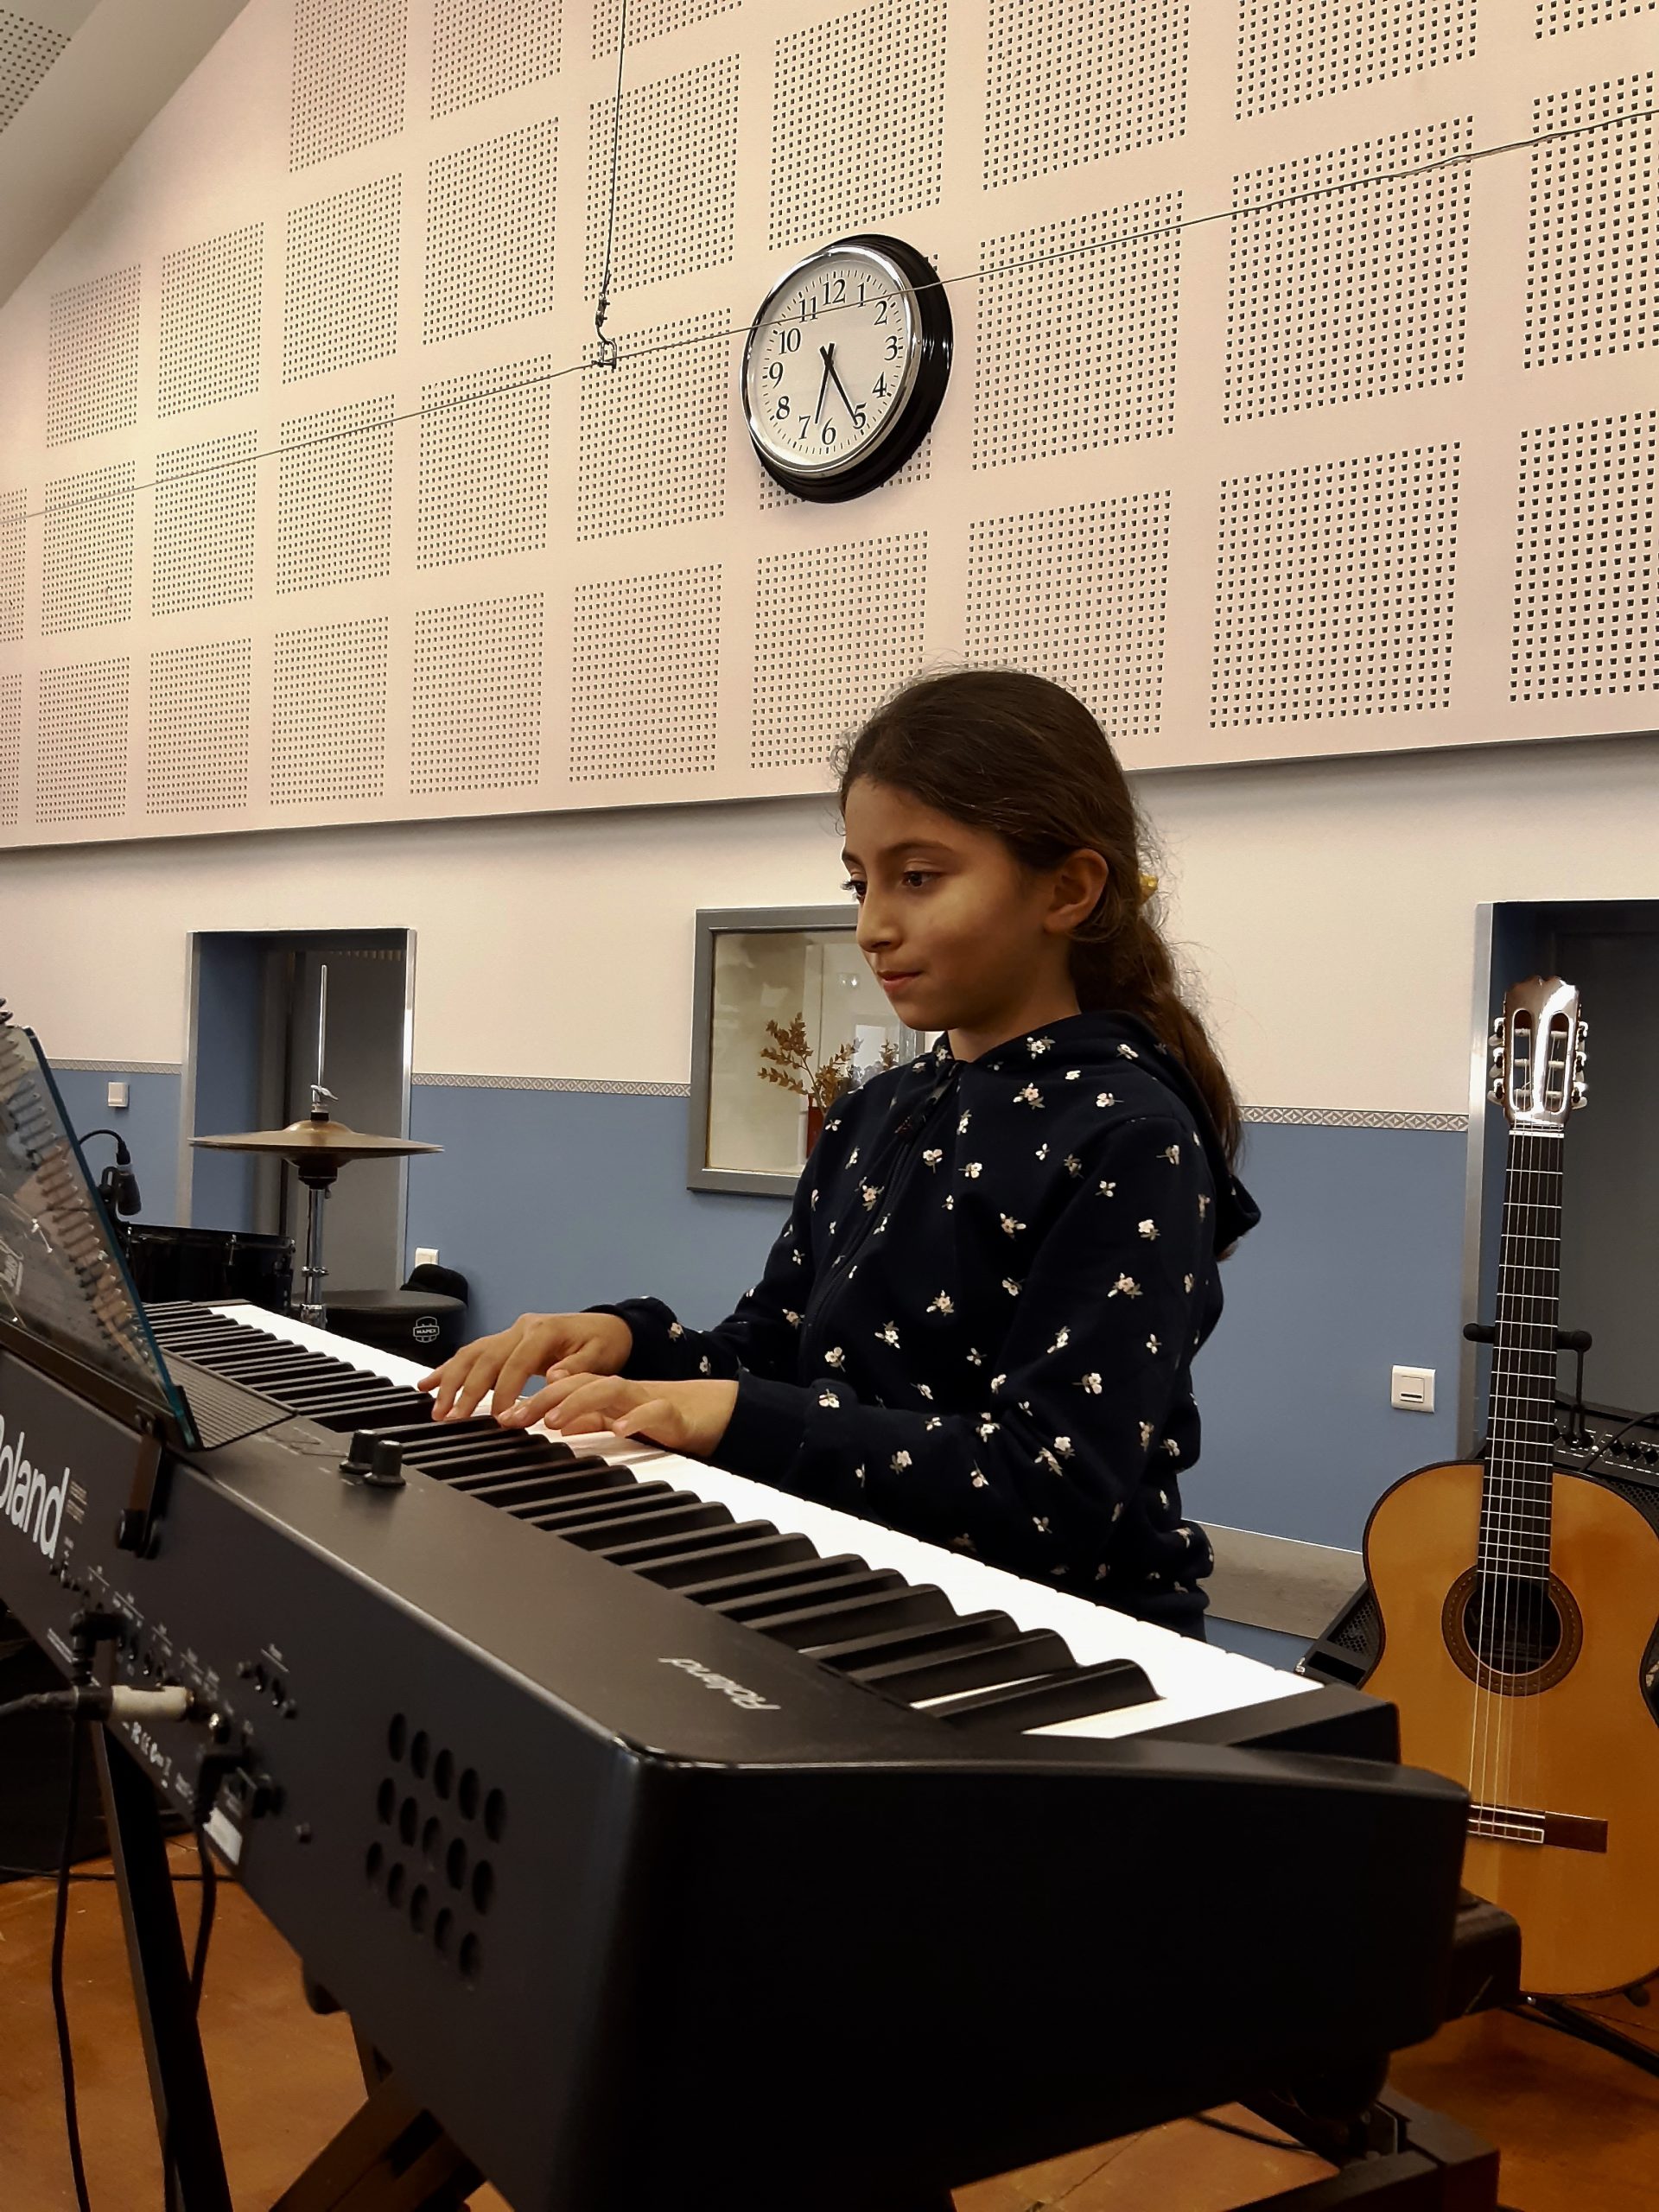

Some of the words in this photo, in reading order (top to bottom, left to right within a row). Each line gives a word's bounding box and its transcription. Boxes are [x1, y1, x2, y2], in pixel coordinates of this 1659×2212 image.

[822, 278, 845, 305] 12
[856, 282, 867, 308] 1
[799, 296, 817, 322] 11
[874, 300, 887, 326] 2
[779, 327, 802, 355] 10
[884, 335, 898, 360] 3
[769, 361, 784, 388] 9
[872, 372, 887, 398] 4
[776, 396, 790, 420] 8
[853, 403, 867, 429] 5
[798, 415, 811, 440] 7
[821, 418, 836, 445] 6
[0, 1414, 71, 1560] oland
[658, 1656, 782, 1710] Roland
